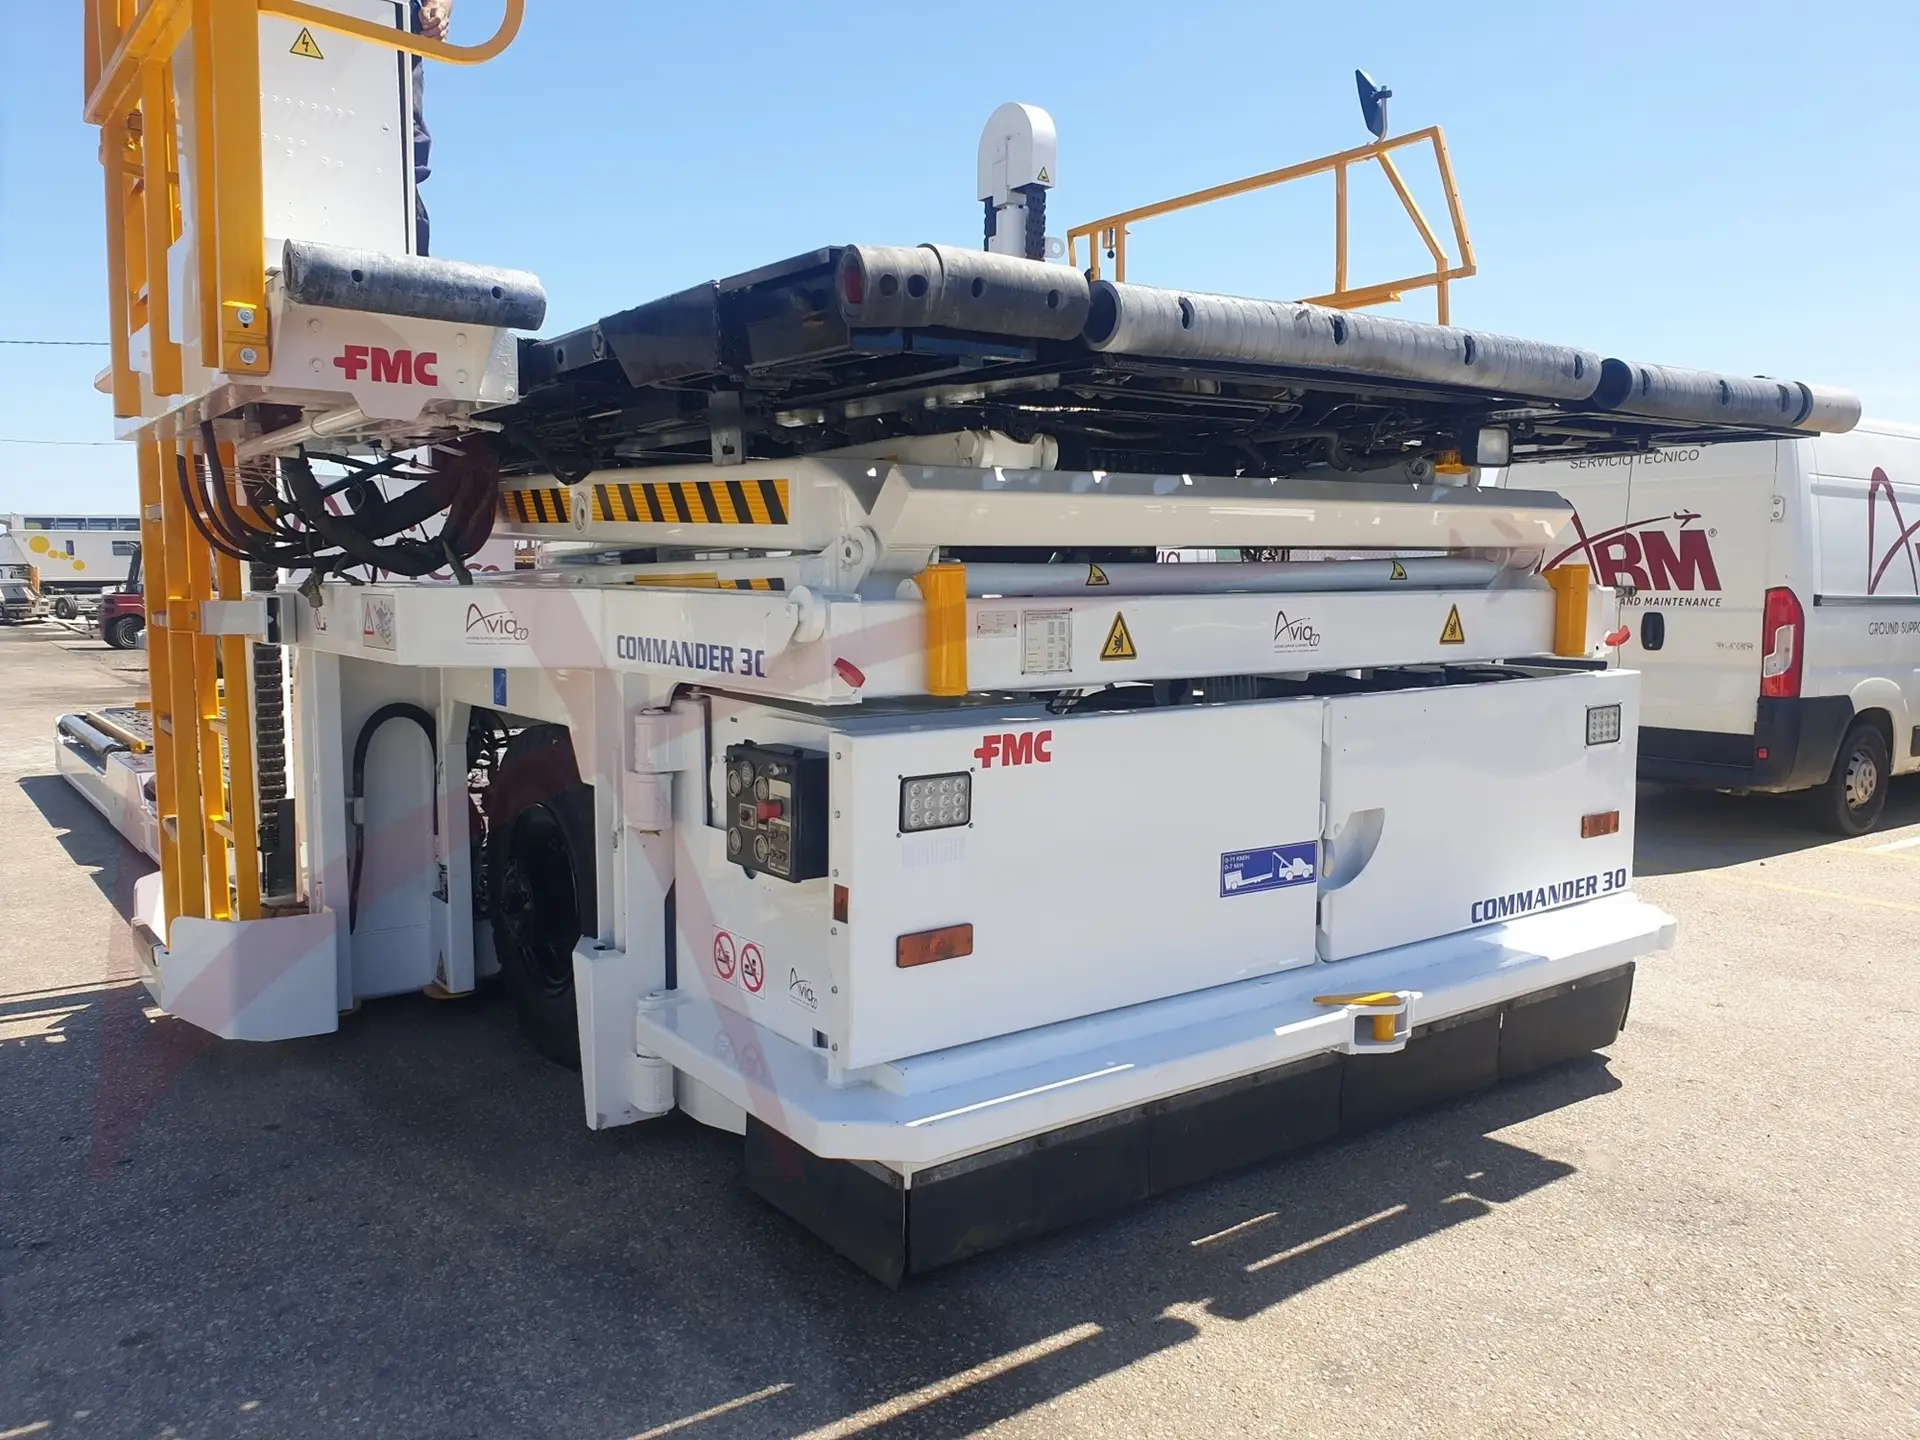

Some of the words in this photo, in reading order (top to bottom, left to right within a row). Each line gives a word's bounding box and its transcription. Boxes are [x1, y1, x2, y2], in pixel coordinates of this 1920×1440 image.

[333, 344, 438, 387] FMC
[1570, 453, 1633, 469] SERVICIO
[1620, 596, 1641, 607] AND
[1644, 597, 1722, 608] MAINTENANCE
[1868, 621, 1899, 636] GROUND
[617, 634, 734, 674] COMMANDER
[974, 730, 1052, 769] FMC
[1471, 875, 1597, 923] COMMANDER
[1602, 868, 1626, 892] 30
